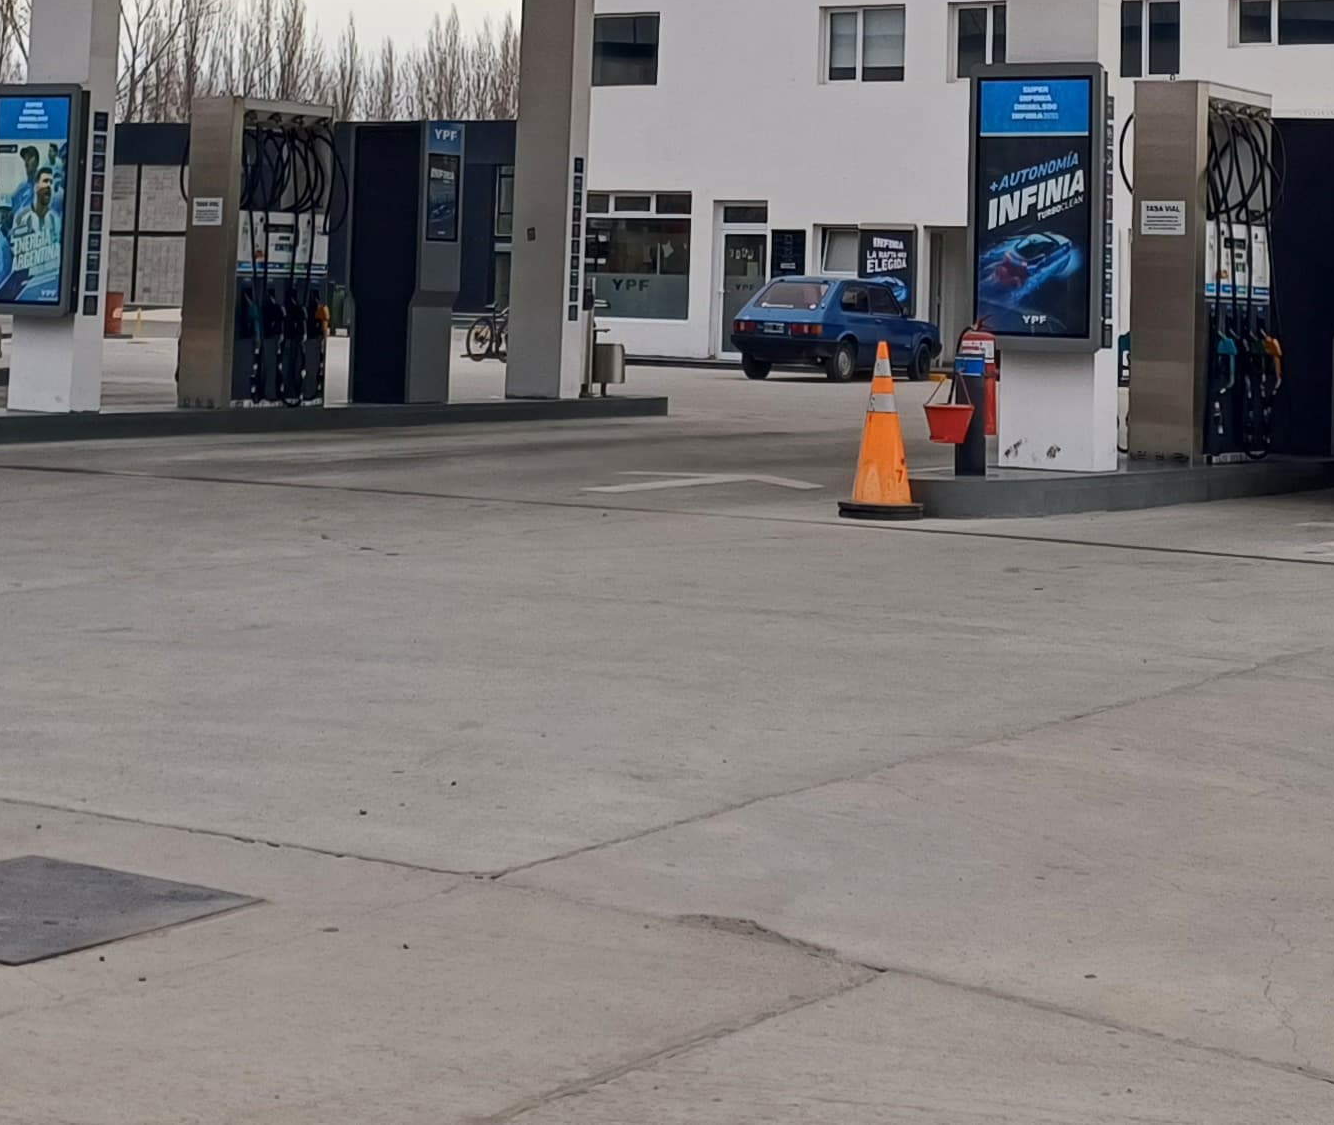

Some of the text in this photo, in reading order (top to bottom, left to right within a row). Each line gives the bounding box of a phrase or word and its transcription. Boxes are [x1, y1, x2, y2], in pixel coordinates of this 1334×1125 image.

[434, 128, 458, 141] YPF
[987, 169, 1085, 231] INFINIA
[867, 258, 907, 273] ELEGIDA
[612, 278, 651, 291] YPF
[735, 283, 755, 291] YPF
[1022, 314, 1047, 324] YPF
